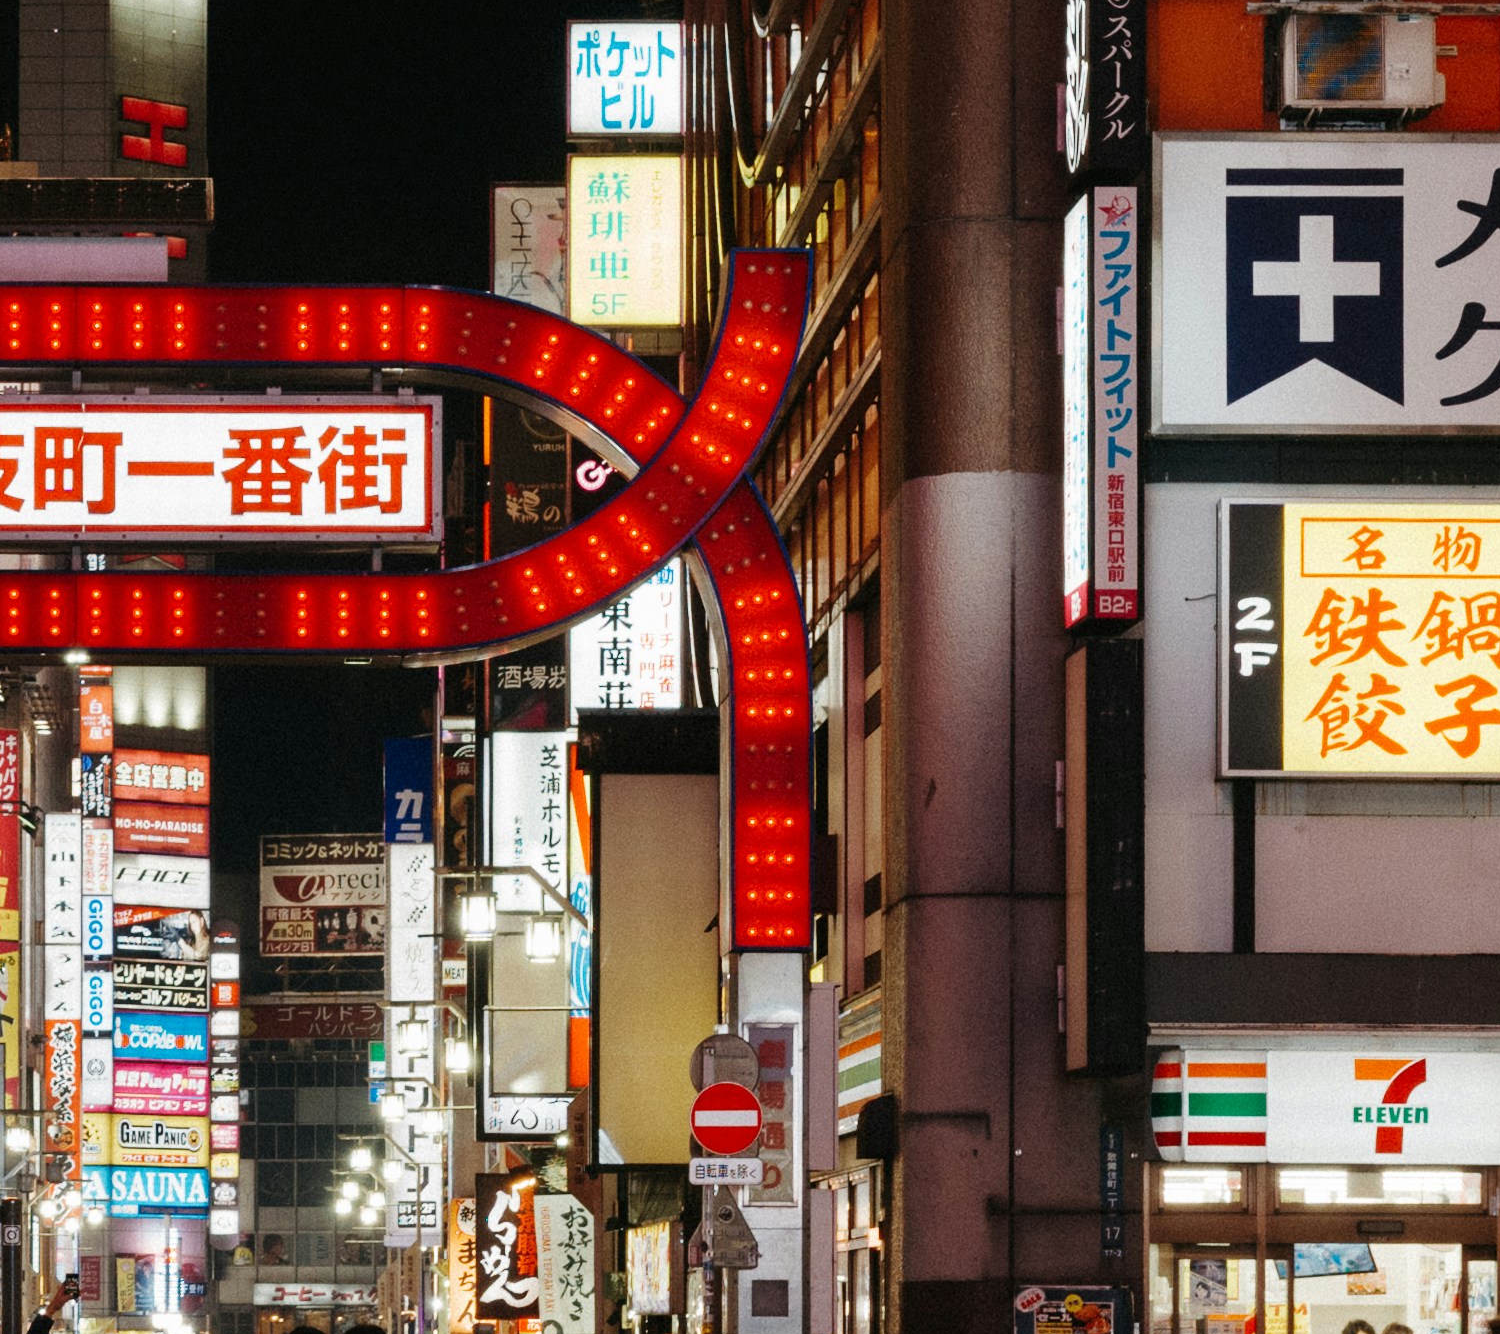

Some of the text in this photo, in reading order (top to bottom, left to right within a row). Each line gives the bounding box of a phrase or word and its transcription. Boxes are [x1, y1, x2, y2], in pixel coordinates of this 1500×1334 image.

[576, 30, 675, 78] ポケット
[1101, 15, 1136, 142] スパークル
[600, 80, 655, 130] ビル
[1099, 229, 1133, 469] ファイトフィット
[1107, 473, 1126, 583] 新宿東口駅前
[1343, 526, 1483, 572] 名物
[1098, 595, 1133, 614] B2F
[658, 591, 676, 695] リーチ麻雀
[114, 761, 205, 792] 全店営業中
[115, 818, 205, 834] MO-MO-PARADISE
[540, 743, 562, 894] 芝浦ホルモン
[115, 867, 205, 885] FACE
[141, 988, 172, 1007] ゴルフ
[120, 1120, 187, 1147] GAME PANIC
[111, 1170, 209, 1205] SAUNA
[695, 1162, 758, 1181] 自転車を除く
[1105, 1226, 1121, 1241] 17
[556, 1205, 594, 1322] お好み焼き
[271, 1287, 326, 1302] コーヒー
